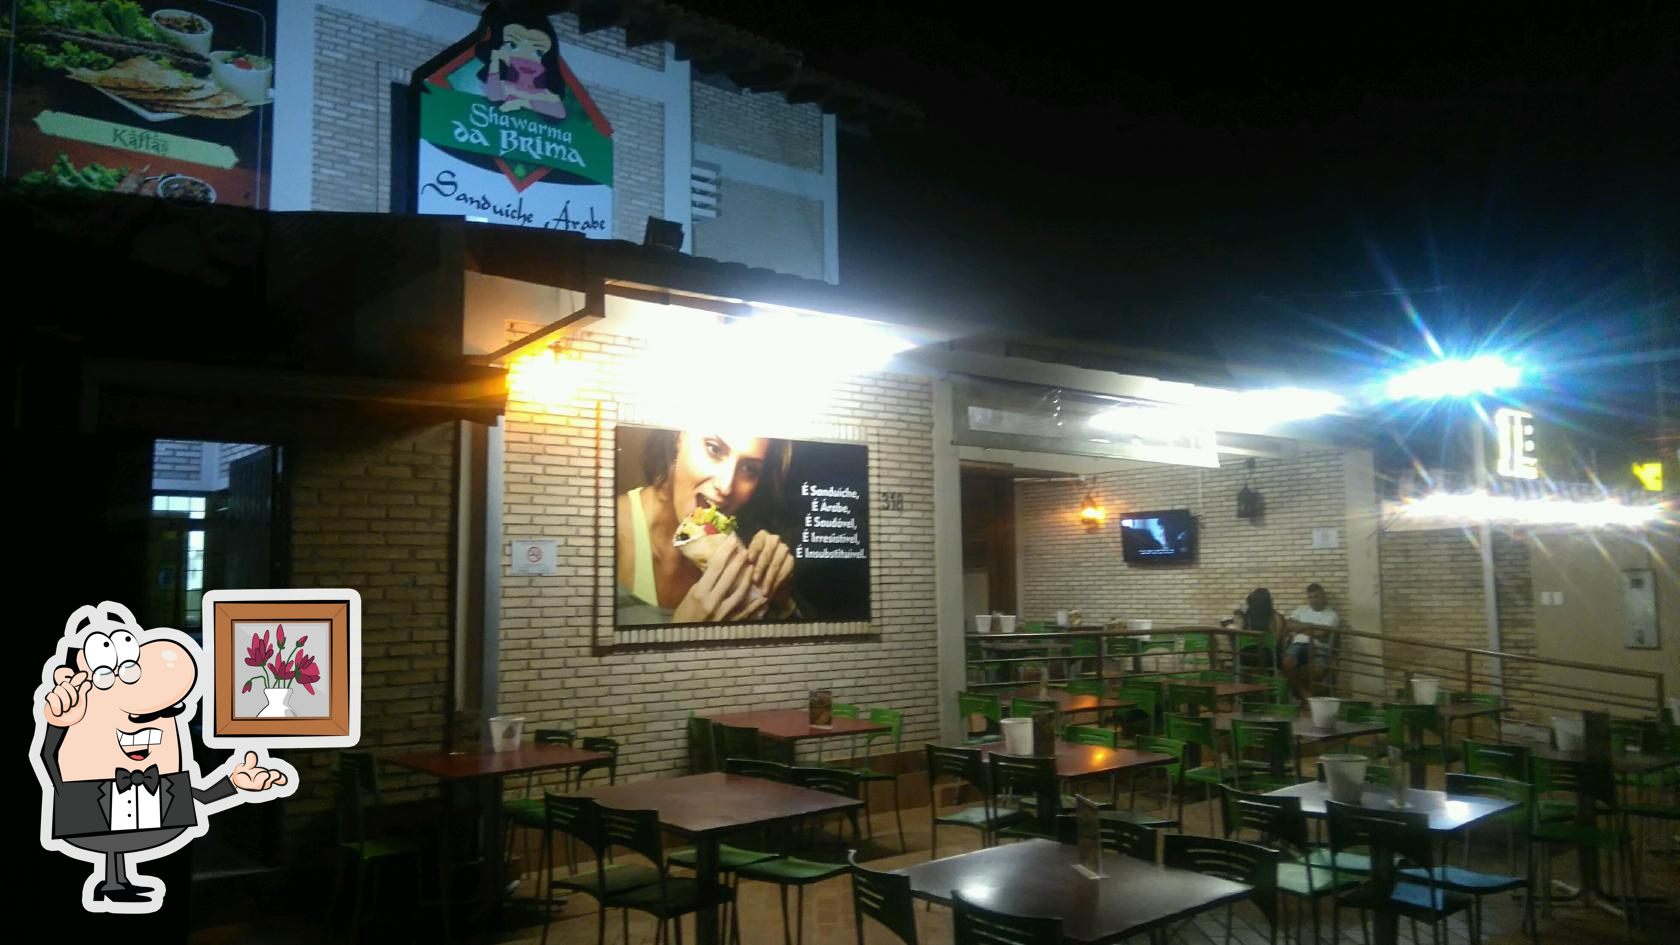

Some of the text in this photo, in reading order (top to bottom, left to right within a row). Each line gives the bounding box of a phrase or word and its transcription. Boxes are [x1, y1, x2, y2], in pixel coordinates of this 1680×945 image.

[469, 103, 572, 144] Shawarma
[544, 200, 605, 230] Árabe
[801, 481, 860, 500] É Sanduíche,
[811, 498, 851, 515] É Árabe,
[805, 513, 858, 530] É Saudável,
[801, 528, 810, 543] É
[795, 544, 804, 559] É
